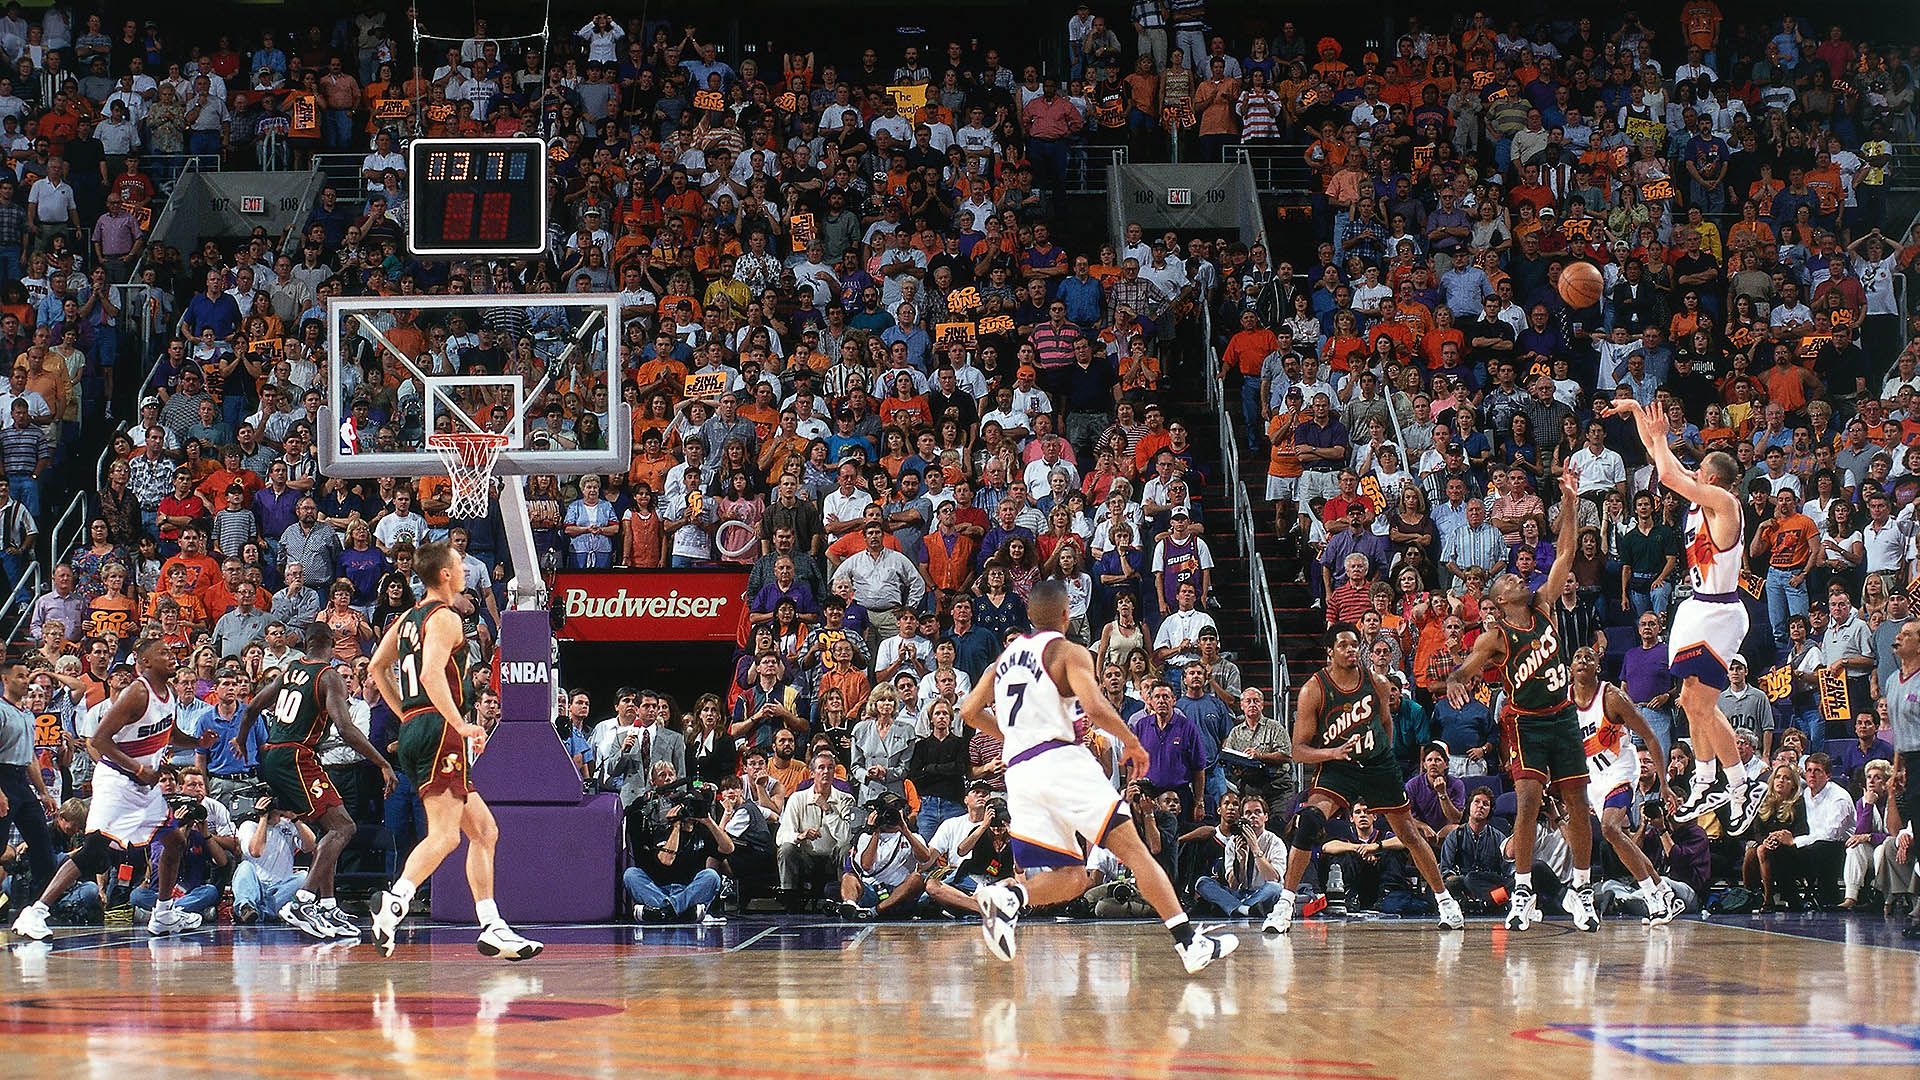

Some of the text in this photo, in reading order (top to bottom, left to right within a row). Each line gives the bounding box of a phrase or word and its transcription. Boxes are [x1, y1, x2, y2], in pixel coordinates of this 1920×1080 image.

[697, 91, 723, 100] GO
[893, 90, 911, 102] The
[694, 99, 725, 112] SUNS
[897, 103, 919, 115] avajo
[1642, 181, 1669, 191] GO
[1134, 190, 1153, 203] 108
[1169, 190, 1189, 204] EXIT
[1205, 190, 1224, 203] 109
[212, 198, 229, 211] 107
[243, 197, 262, 211] EXIT
[280, 198, 299, 211] 108
[1564, 220, 1592, 228] GO
[947, 293, 982, 313] SUNS
[945, 327, 968, 336] SINK
[979, 319, 1015, 335] SUNS
[695, 375, 720, 386] SINK
[686, 382, 725, 394] SEATTLE
[1178, 573, 1191, 583] 32
[566, 588, 727, 619] Budweiser
[91, 610, 129, 623] GO
[1513, 624, 1558, 688] SONICS
[1674, 648, 1703, 664] OENIX
[510, 662, 549, 684] NBA
[1544, 663, 1567, 692] 33
[1824, 669, 1840, 719] SEATTLE
[1835, 679, 1848, 709] SINK
[1006, 683, 1027, 727] 7
[138, 713, 173, 738] SUNS
[1323, 695, 1373, 745] SONICS
[1731, 714, 1755, 730] OLO
[1353, 730, 1374, 754] 14
[1592, 753, 1612, 771] 11
